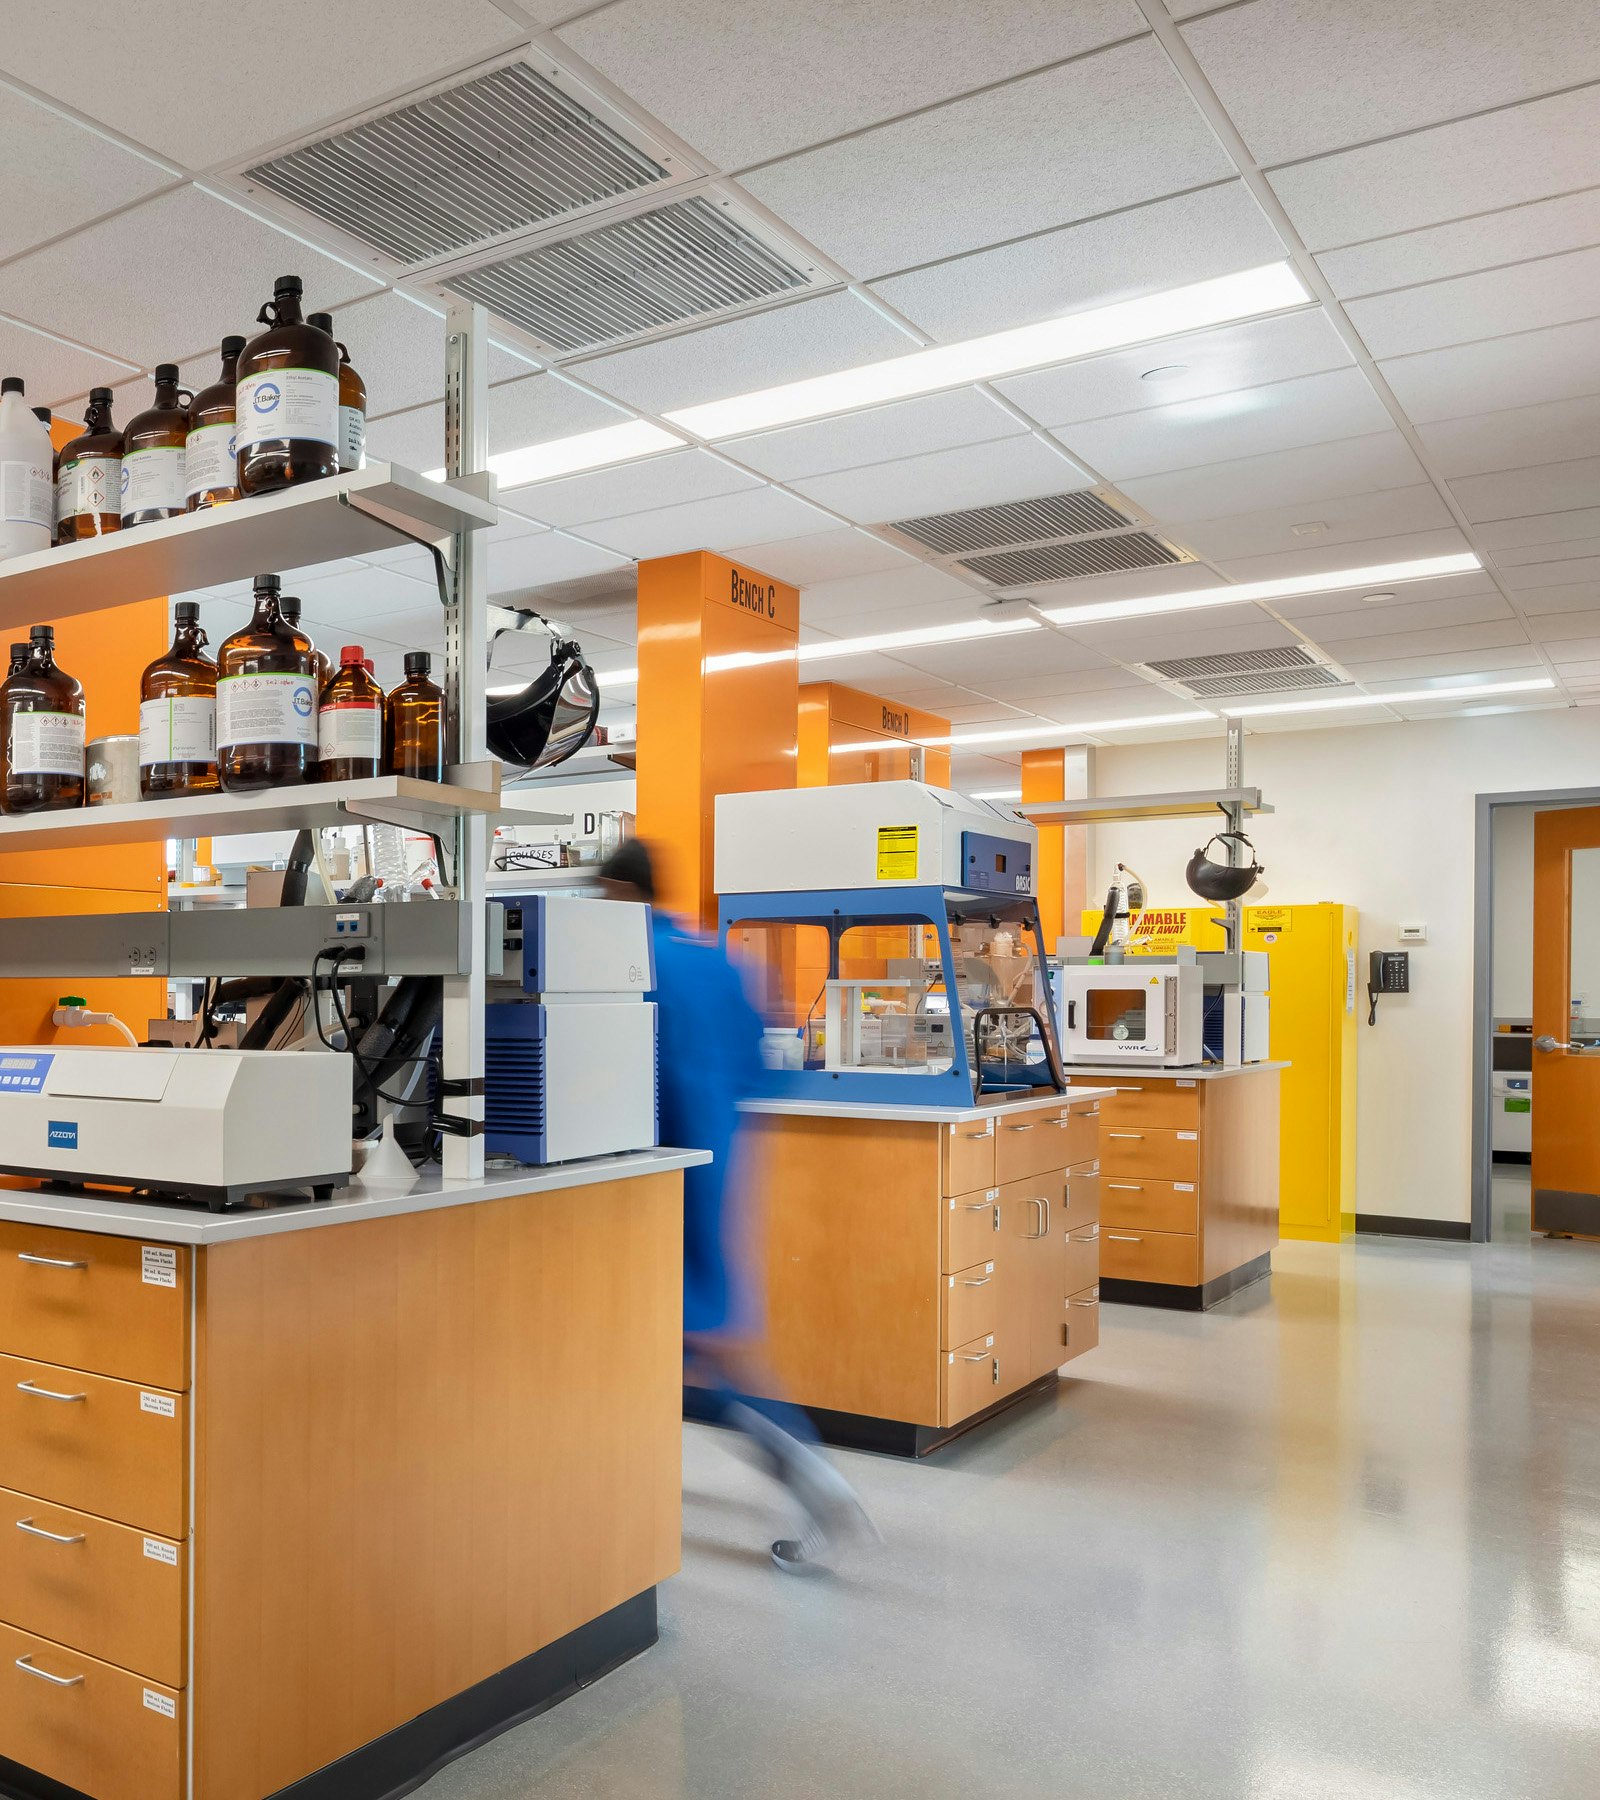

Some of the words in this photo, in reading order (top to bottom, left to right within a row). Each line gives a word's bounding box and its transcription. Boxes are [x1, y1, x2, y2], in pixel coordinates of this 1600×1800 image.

[731, 569, 764, 614] BENCH
[767, 585, 776, 618] C
[882, 706, 902, 732] BENCH
[903, 713, 910, 735] D
[509, 850, 554, 861] COURSES
[1015, 875, 1031, 891] BASIC
[1129, 913, 1186, 925] MMABLE
[1135, 926, 1156, 935] FIRE
[1157, 925, 1185, 935] AWAY
[49, 1131, 76, 1140] AZZOTA
